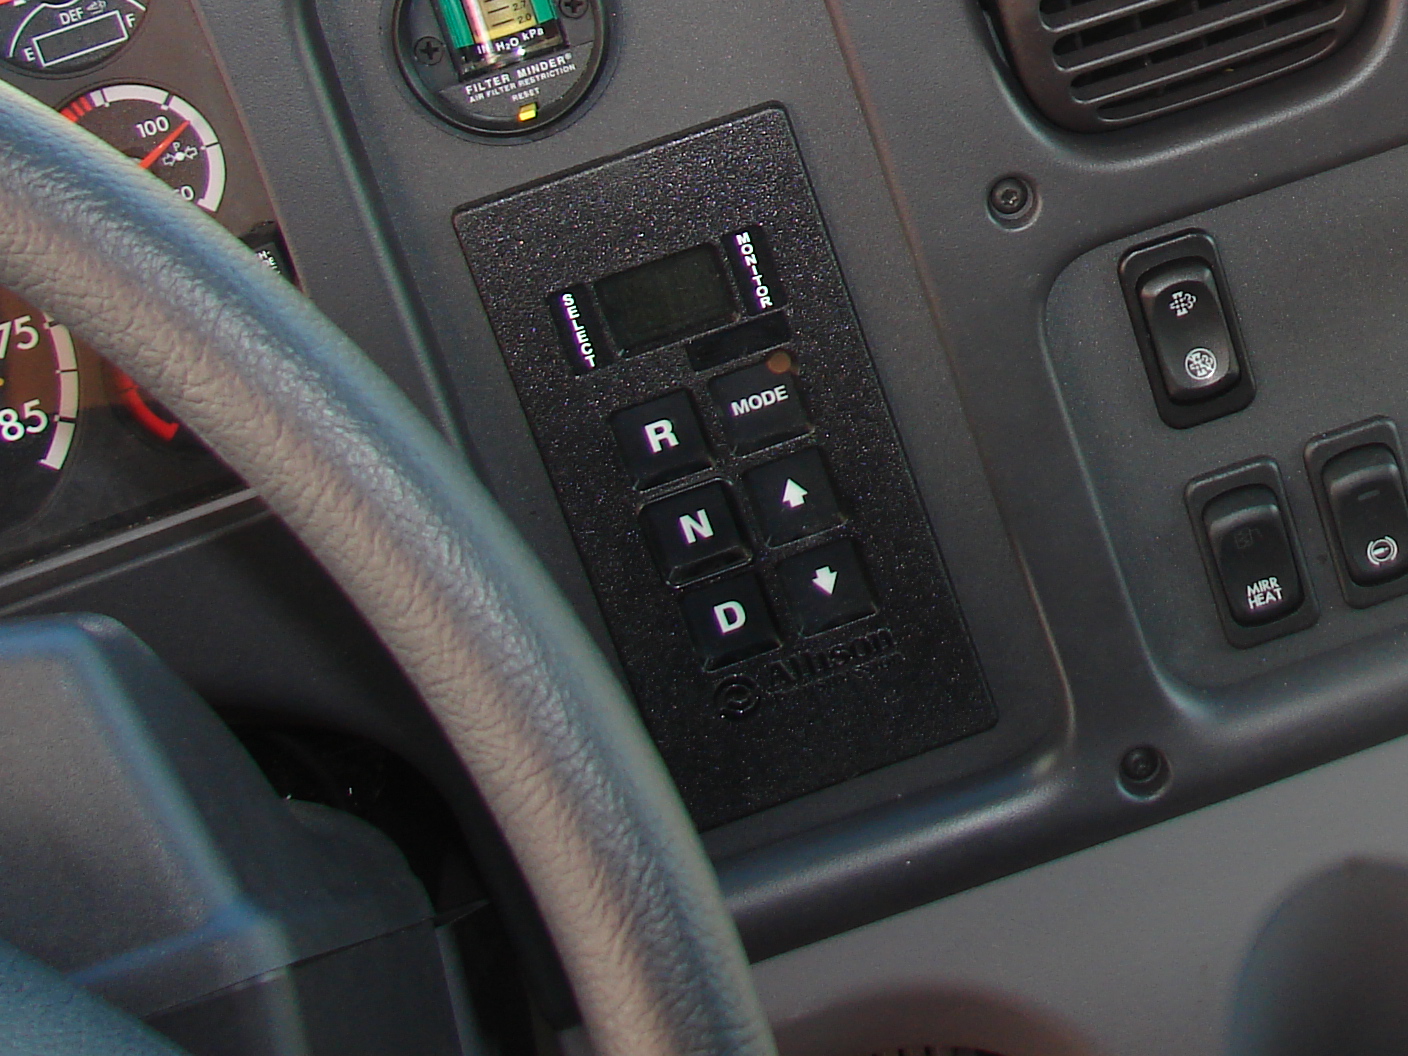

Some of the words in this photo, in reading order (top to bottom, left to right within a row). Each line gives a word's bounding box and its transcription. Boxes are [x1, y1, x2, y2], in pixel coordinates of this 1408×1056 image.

[59, 7, 84, 26] DEF
[125, 13, 136, 28] F
[517, 13, 532, 25] 2.0
[522, 27, 545, 42] kPa
[24, 46, 35, 62] E
[465, 73, 511, 95] FILTER
[486, 83, 517, 98] FILTER
[518, 63, 576, 87] RESTRICTION
[511, 87, 541, 102] RESET
[136, 116, 170, 139] 100
[736, 232, 773, 310] MONITOR
[562, 293, 596, 369] SELECT
[731, 385, 789, 418] MODE
[0, 399, 48, 441] 85
[644, 419, 679, 454] R
[679, 508, 714, 545] N
[1246, 576, 1280, 598] MIRR
[1248, 587, 1282, 610] HEAT
[714, 600, 747, 634] D
